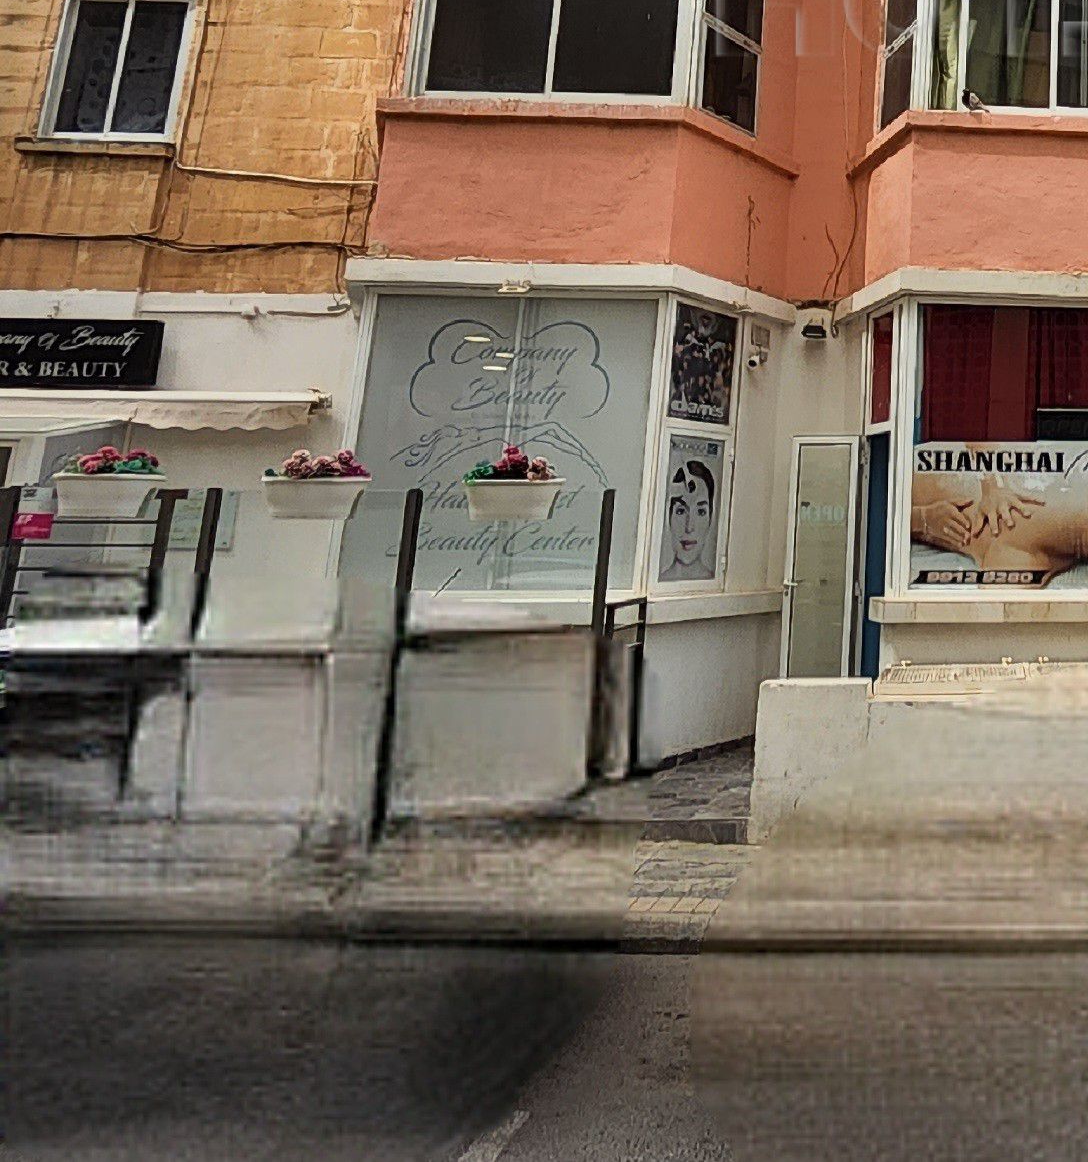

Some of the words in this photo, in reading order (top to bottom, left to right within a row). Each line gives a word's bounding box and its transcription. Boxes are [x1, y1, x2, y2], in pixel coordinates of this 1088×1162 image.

[59, 325, 145, 357] Beauty
[14, 362, 33, 377] &
[37, 361, 128, 378] BEAUTY
[916, 449, 1064, 474] SHANGHAI
